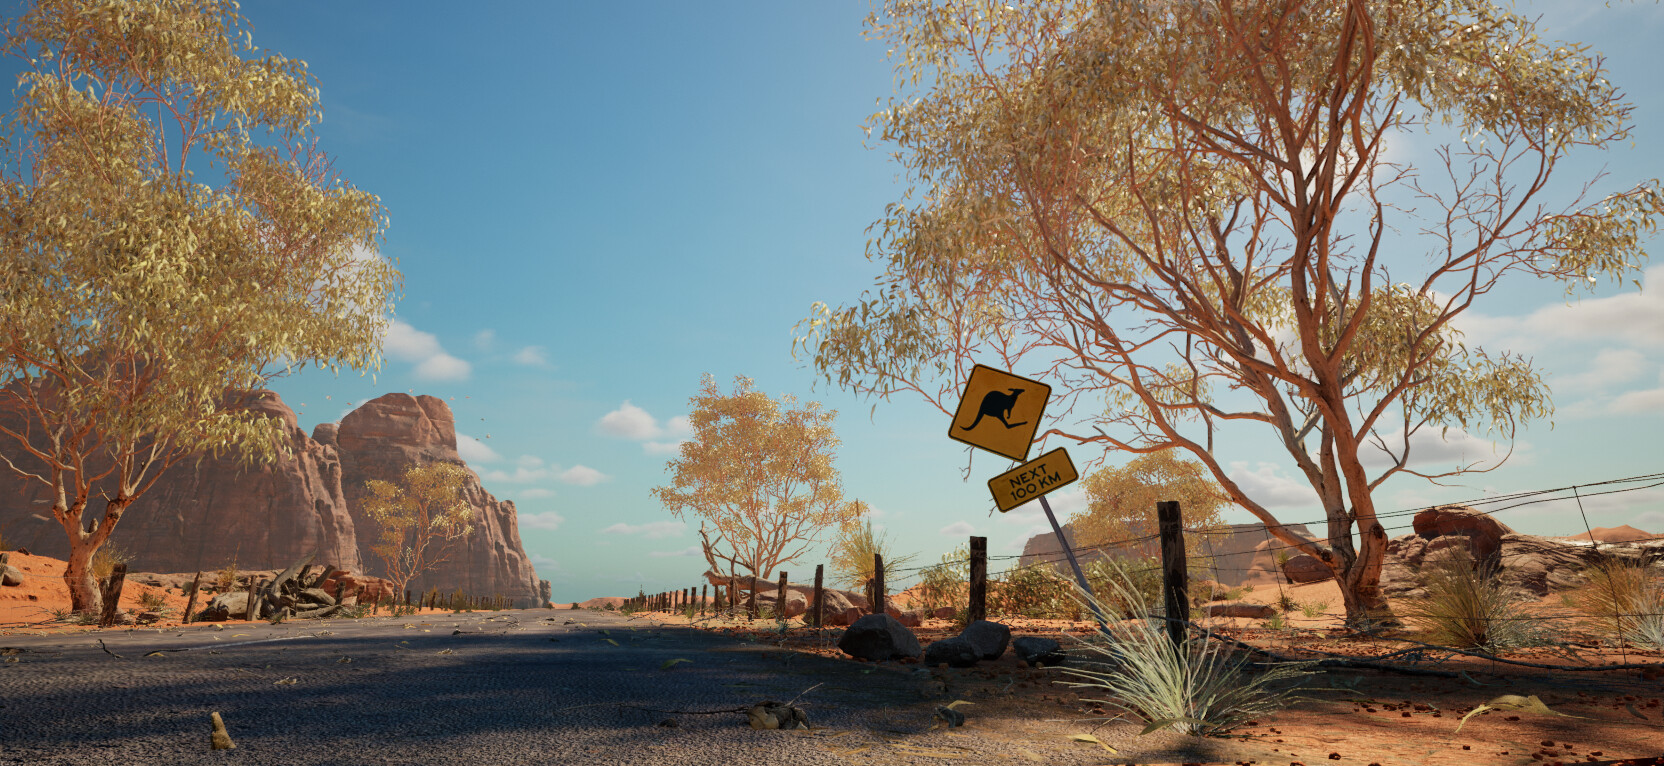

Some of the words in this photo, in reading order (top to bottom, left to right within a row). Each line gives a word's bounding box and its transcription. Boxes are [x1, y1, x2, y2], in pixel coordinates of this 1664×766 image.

[1009, 463, 1046, 488] NEXT
[1010, 483, 1037, 501] 100
[1038, 471, 1061, 489] KM
